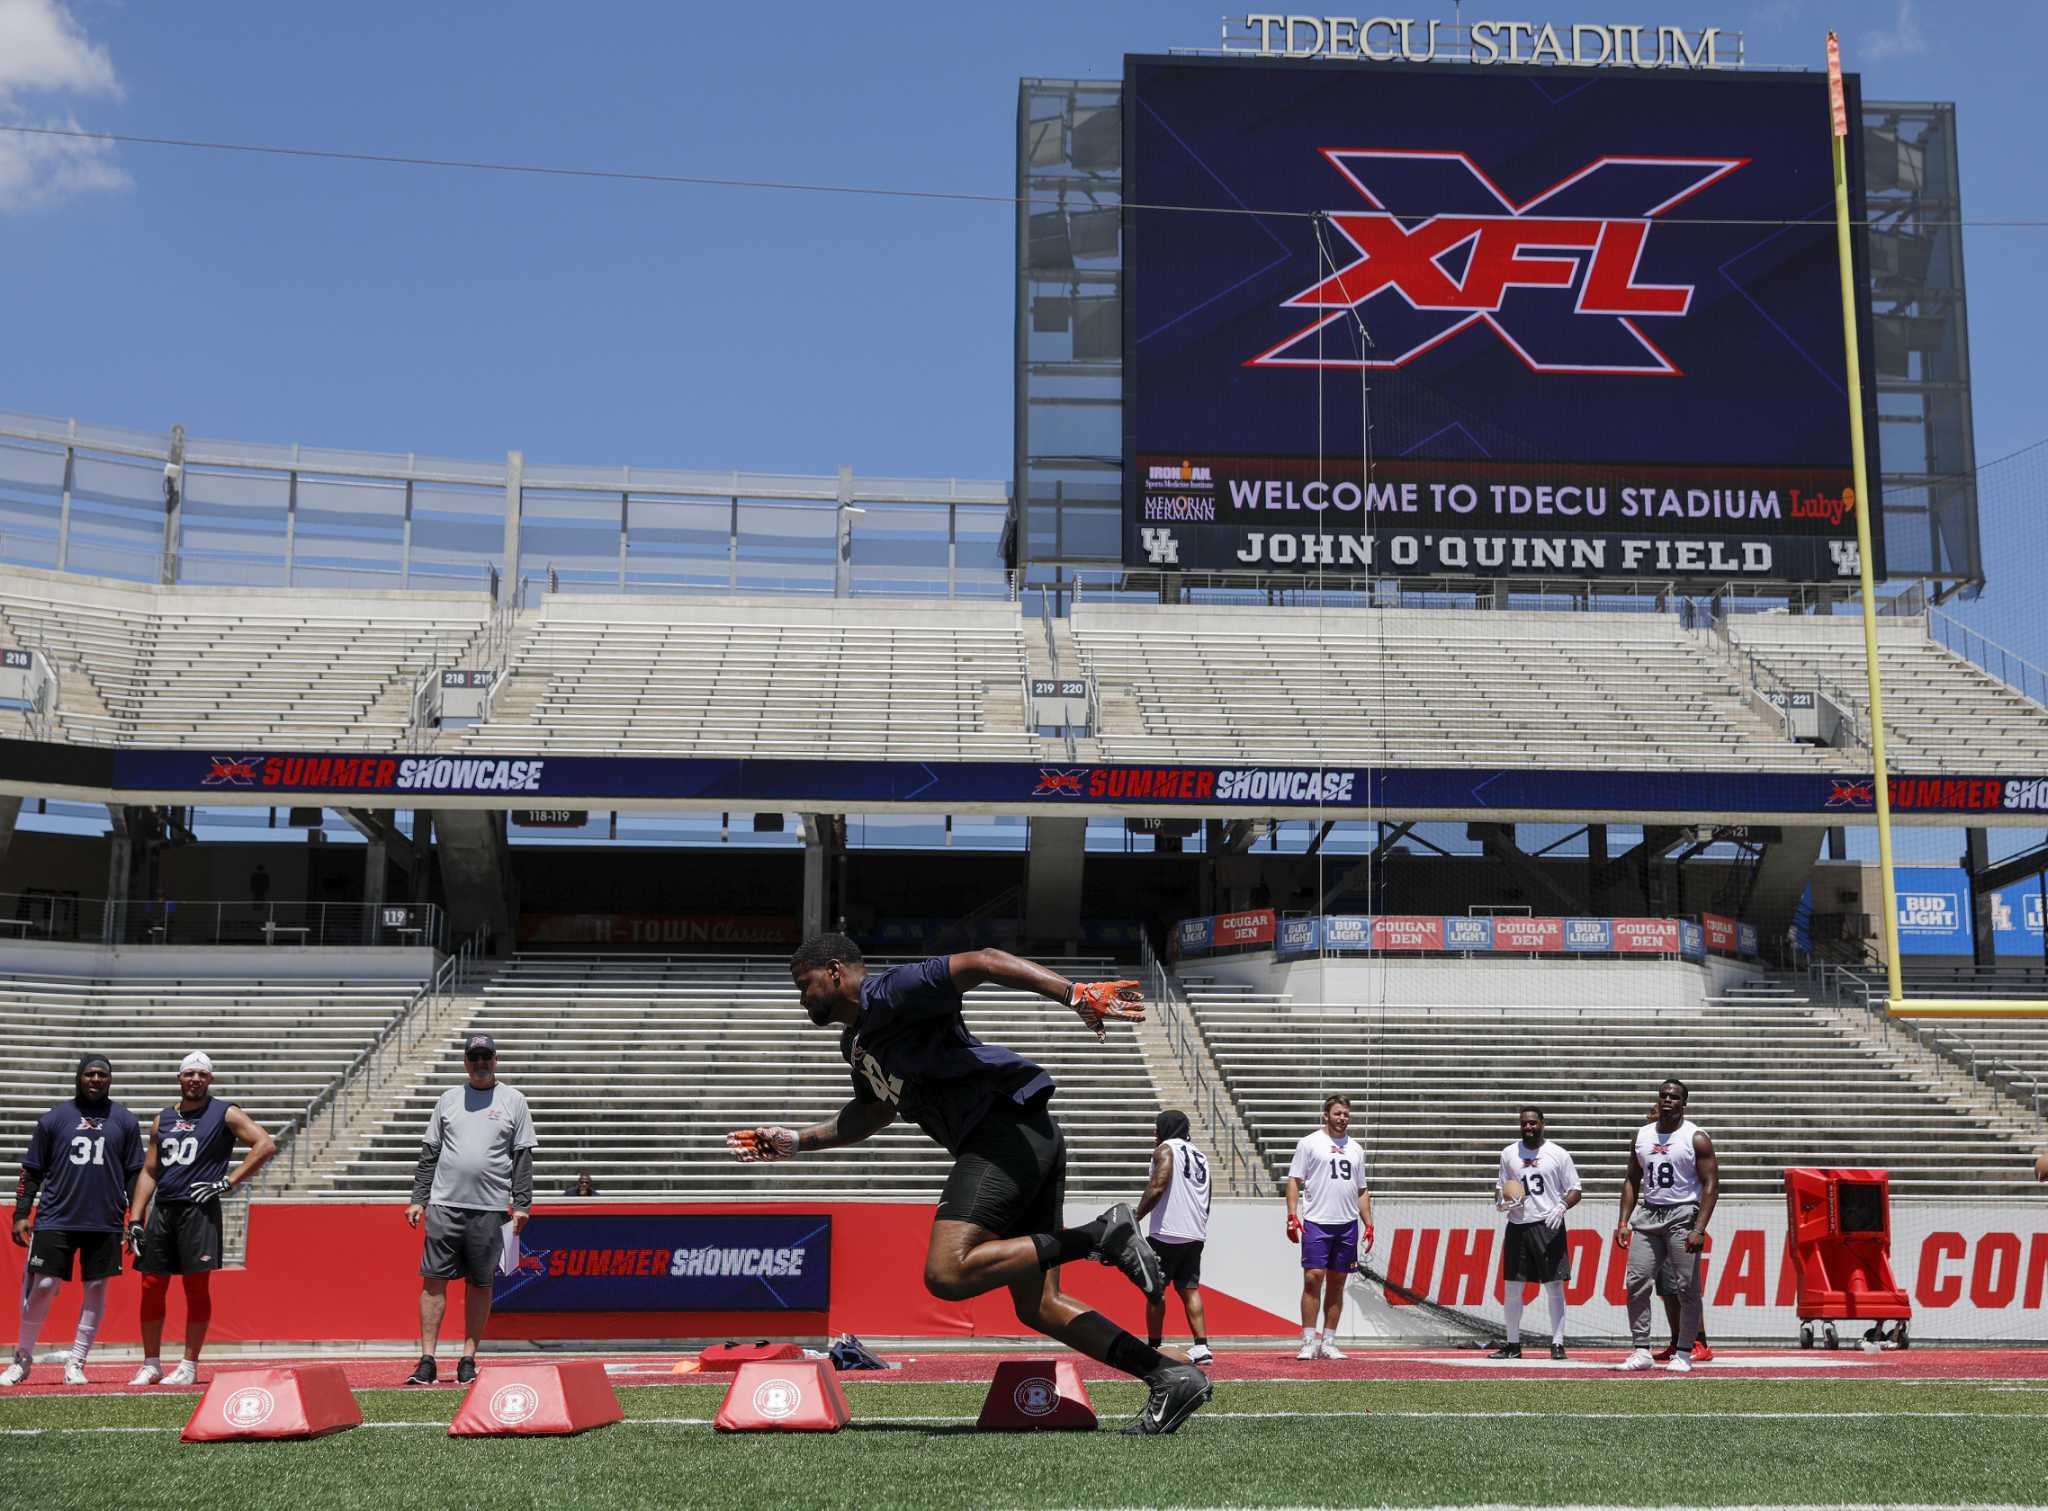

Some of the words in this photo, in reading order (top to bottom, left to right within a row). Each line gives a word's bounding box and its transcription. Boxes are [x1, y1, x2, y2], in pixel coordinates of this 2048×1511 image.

[1246, 14, 1440, 62] TDECU
[1470, 20, 1720, 69] STADIUM
[1145, 496, 1215, 511] MEMORIAL
[1229, 480, 1417, 512] WELCOME
[1430, 484, 1478, 513] TO
[1490, 486, 1606, 516] TDECU
[1621, 487, 1781, 519] STADIUM
[1145, 507, 1215, 520] HERMANN
[1237, 533, 1374, 565] JOHN
[1391, 535, 1606, 568] O'QUINN
[1621, 539, 1773, 571] FIELD
[6, 652, 27, 666] 218
[445, 673, 464, 684] 218
[1036, 682, 1055, 694] 219
[1062, 683, 1083, 694] 220
[1792, 694, 1810, 705] 221
[262, 757, 396, 787] SUMMER
[397, 757, 544, 790] SHOWCASE
[1088, 769, 1214, 797] SUMMER
[1216, 769, 1355, 800] SHOWCASE
[528, 810, 570, 822] 118-119
[1906, 897, 1946, 911] BUD
[384, 911, 405, 922] 119
[1223, 915, 1268, 929] COUGAR
[1900, 911, 1953, 926] LIGHT
[1288, 922, 1307, 933] BUD
[1334, 920, 1361, 931] BUD
[1376, 921, 1436, 932] COUGAR
[1456, 921, 1481, 932] BUD
[1497, 923, 1557, 934] COUGAR
[1574, 923, 1601, 933] BUD
[1617, 924, 1676, 935] COUGAR
[1284, 931, 1312, 944] LIGHT
[1329, 930, 1365, 941] LIGHT
[1391, 933, 1422, 944] DEN
[1451, 931, 1487, 941] LIGHT
[1512, 934, 1543, 945] DEN
[1569, 932, 1606, 943] LIGHT
[1632, 936, 1663, 947] DEN
[69, 1136, 105, 1165] 31
[160, 1137, 199, 1166] 30
[1181, 1145, 1206, 1184] 15
[1329, 1158, 1351, 1180] 19
[1647, 1161, 1674, 1188] 18
[1521, 1174, 1544, 1196] 13
[549, 1248, 671, 1276] SUMMER
[671, 1245, 806, 1277] SHOWCASE
